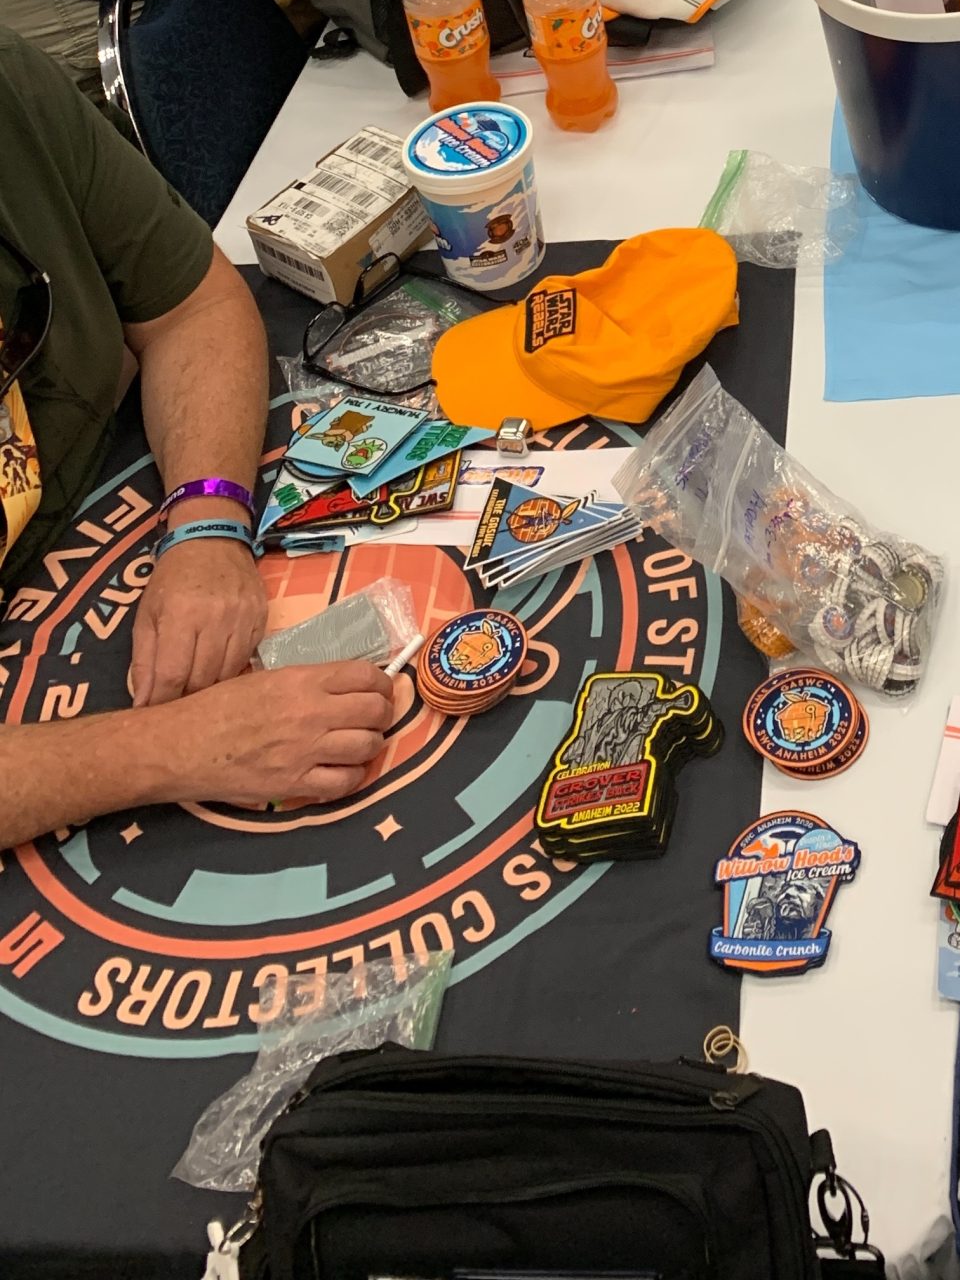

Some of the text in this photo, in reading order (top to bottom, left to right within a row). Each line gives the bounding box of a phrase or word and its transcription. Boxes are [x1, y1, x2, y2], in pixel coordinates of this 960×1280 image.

[438, 6, 486, 49] Crush
[581, 8, 604, 41] Cru
[456, 142, 491, 167] Cream
[526, 290, 546, 350] REBELS
[544, 294, 562, 338] WARS
[558, 291, 577, 336] STAR
[372, 403, 421, 419] HUNGRY
[413, 491, 449, 508] SWC
[482, 497, 508, 549] THE GASWC
[1, 485, 153, 622] FIVE
[642, 547, 699, 602] OF
[83, 548, 156, 641] 017
[486, 613, 520, 637] GASWC
[430, 637, 501, 689] SWC ANAHEIM 2022
[643, 617, 700, 691] ST
[780, 677, 825, 692] GASWC
[755, 719, 849, 762] SWC ANAHEIM 2022
[556, 760, 611, 780] CELEBRATION
[556, 770, 641, 797] GROVER
[552, 782, 640, 813] STRIKES BACK
[572, 801, 641, 823] ANAHEIM 2022
[740, 829, 756, 848] SWC
[756, 816, 792, 834] ANAHEIM
[793, 843, 856, 868] Hood's
[787, 863, 852, 882] Ice Cream
[77, 890, 497, 1031] COLLECTORS
[713, 940, 822, 959] Carbonite Crunch
